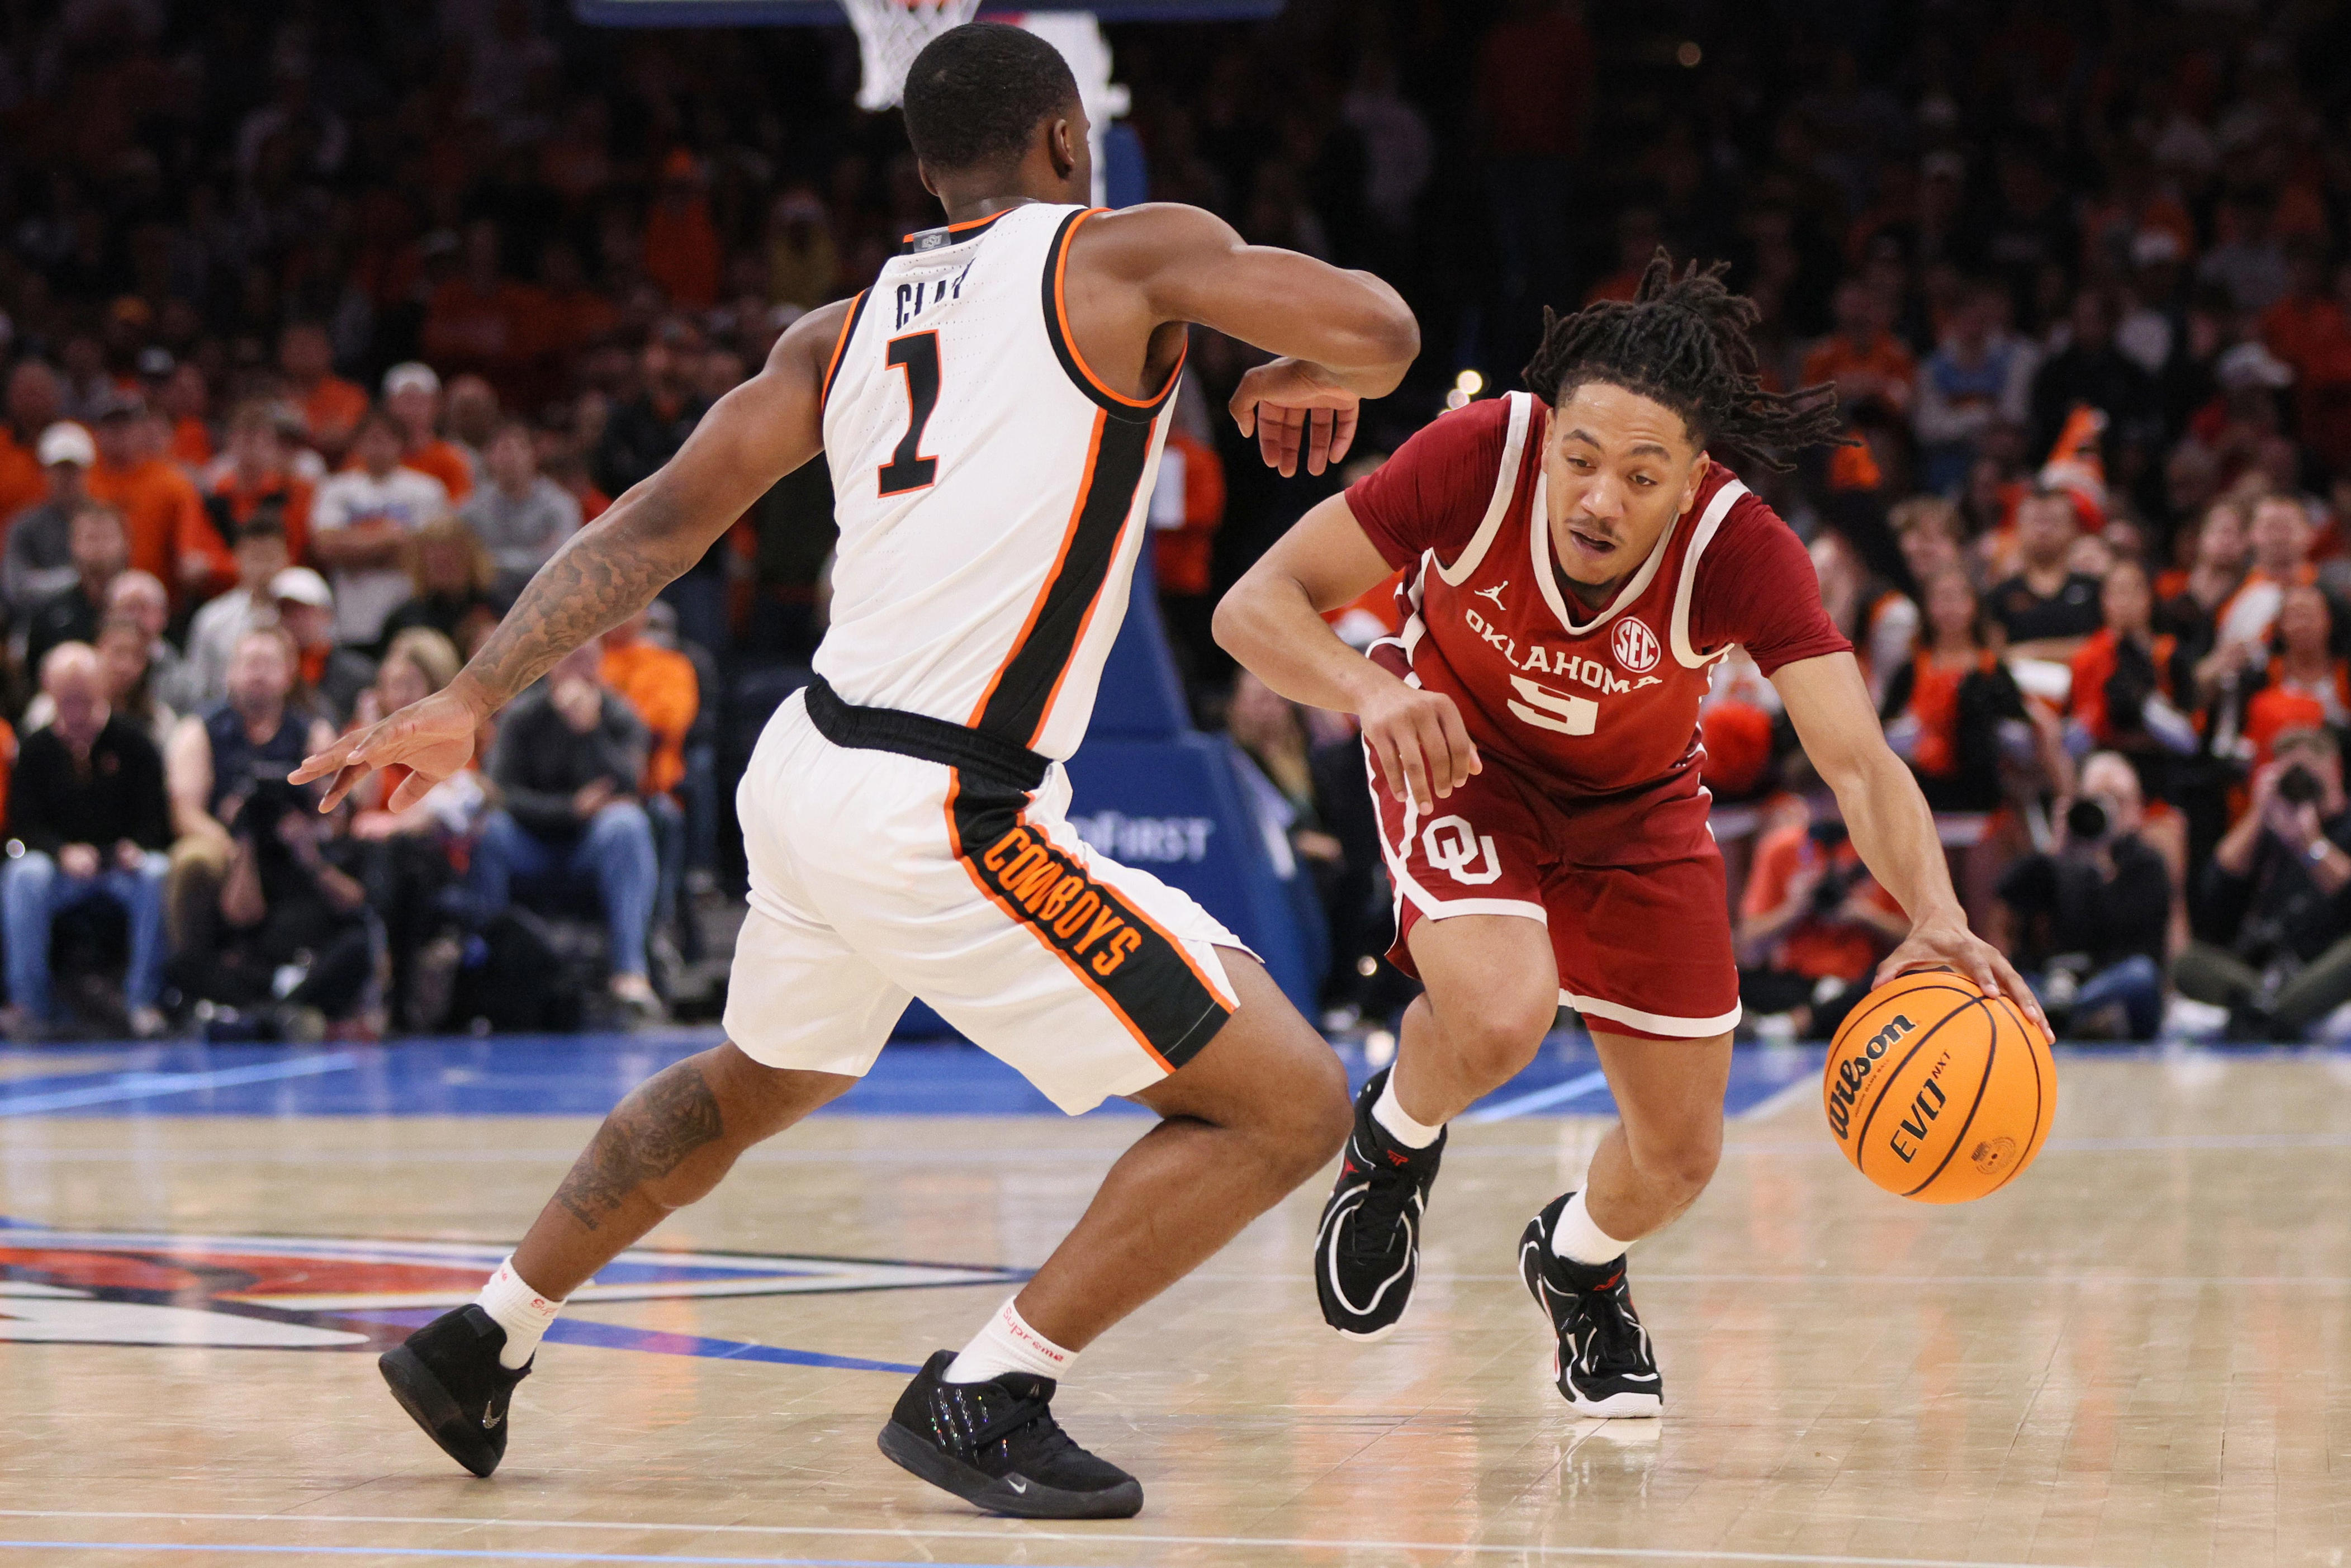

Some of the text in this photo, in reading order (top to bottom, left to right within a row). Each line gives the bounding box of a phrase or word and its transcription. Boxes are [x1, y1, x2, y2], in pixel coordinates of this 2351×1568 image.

[878, 329, 942, 498] 1
[1466, 609, 1662, 695] OKLAHOMA
[1615, 620, 1656, 669] SEC
[1507, 674, 1599, 736] 5
[1421, 814, 1502, 885] OU
[984, 827, 1142, 975] COWBOYS
[1829, 1015, 1916, 1140] Wilson
[1931, 1049, 1951, 1079] NXT
[1003, 1306, 1064, 1362] Supreme
